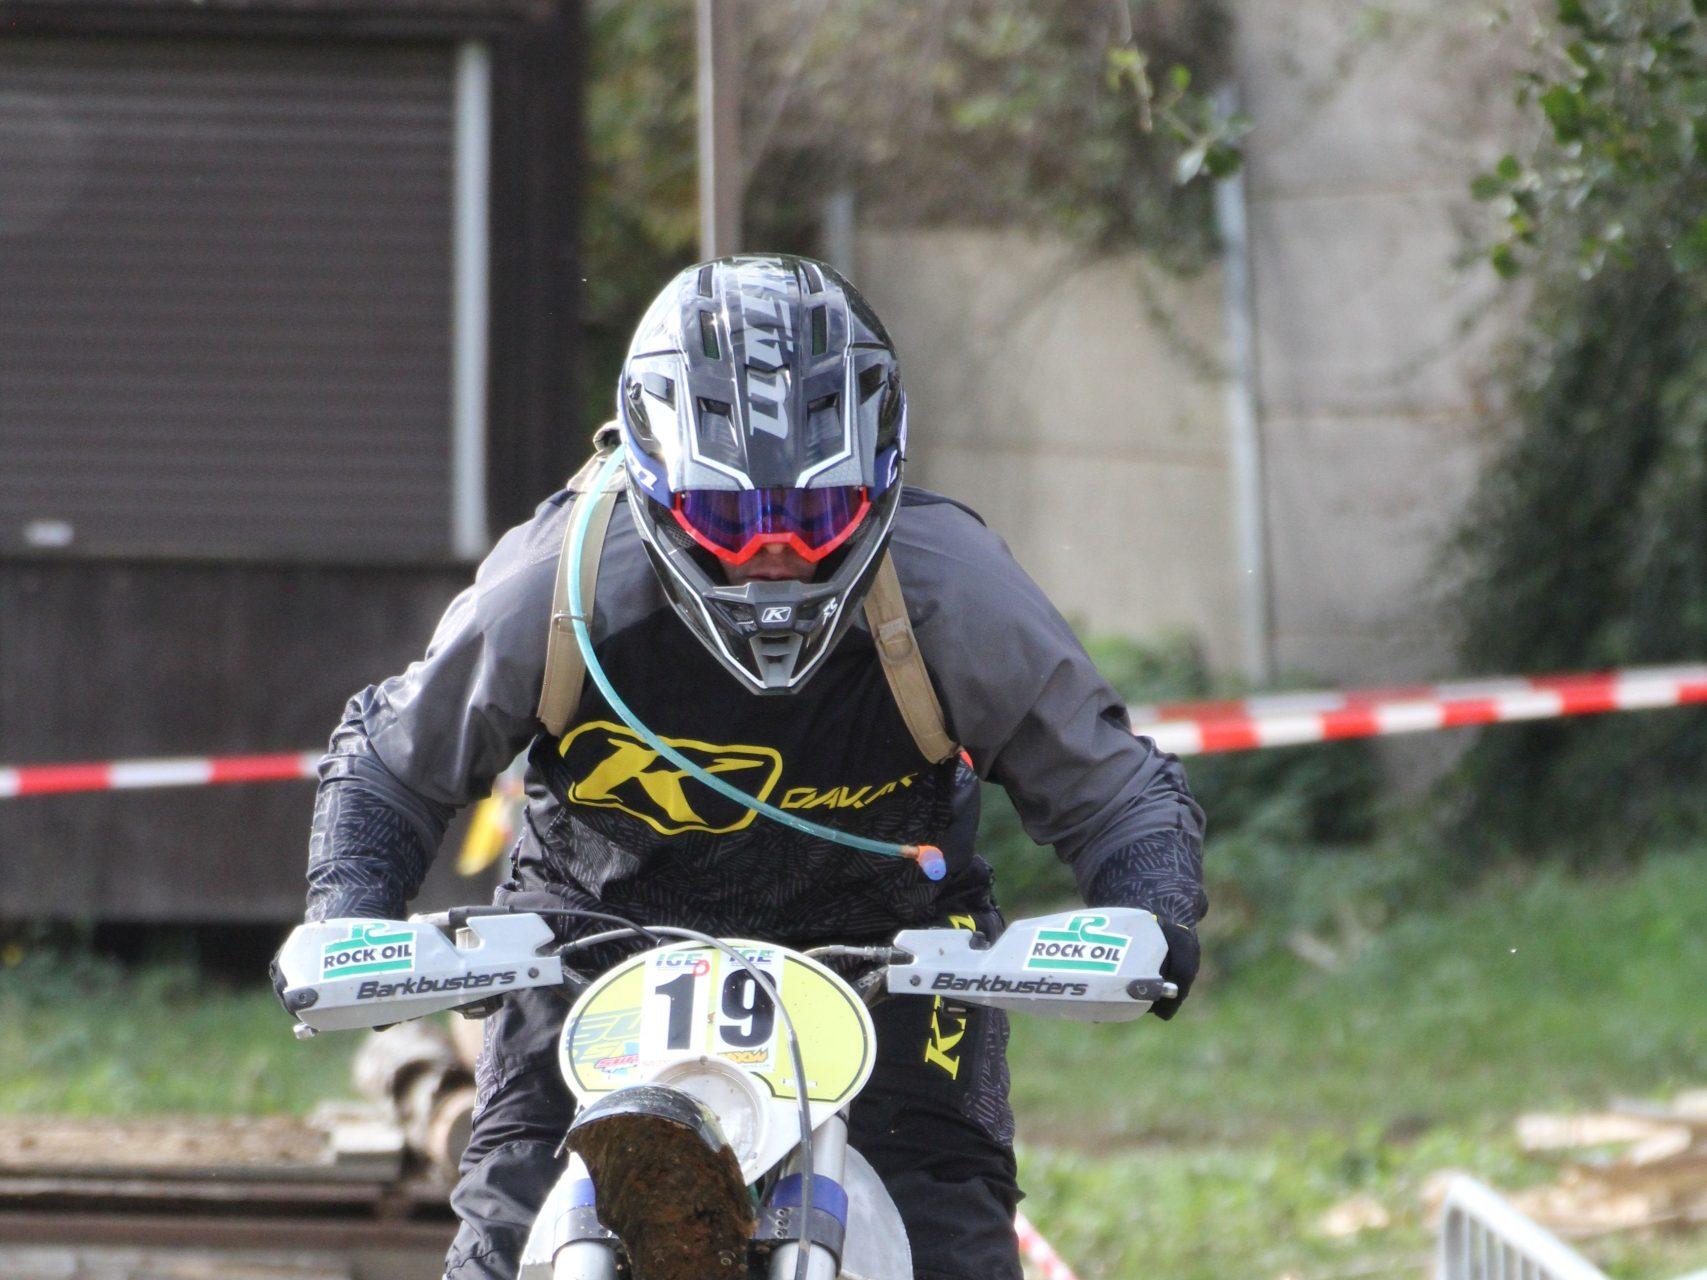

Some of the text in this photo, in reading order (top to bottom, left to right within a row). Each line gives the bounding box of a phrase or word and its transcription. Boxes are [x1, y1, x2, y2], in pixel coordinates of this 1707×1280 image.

[323, 944, 413, 970] ROCK OIL
[1032, 942, 1122, 963] ROCK OIL
[356, 969, 518, 1001] Barkbusters
[930, 972, 1088, 997] Barkbusters
